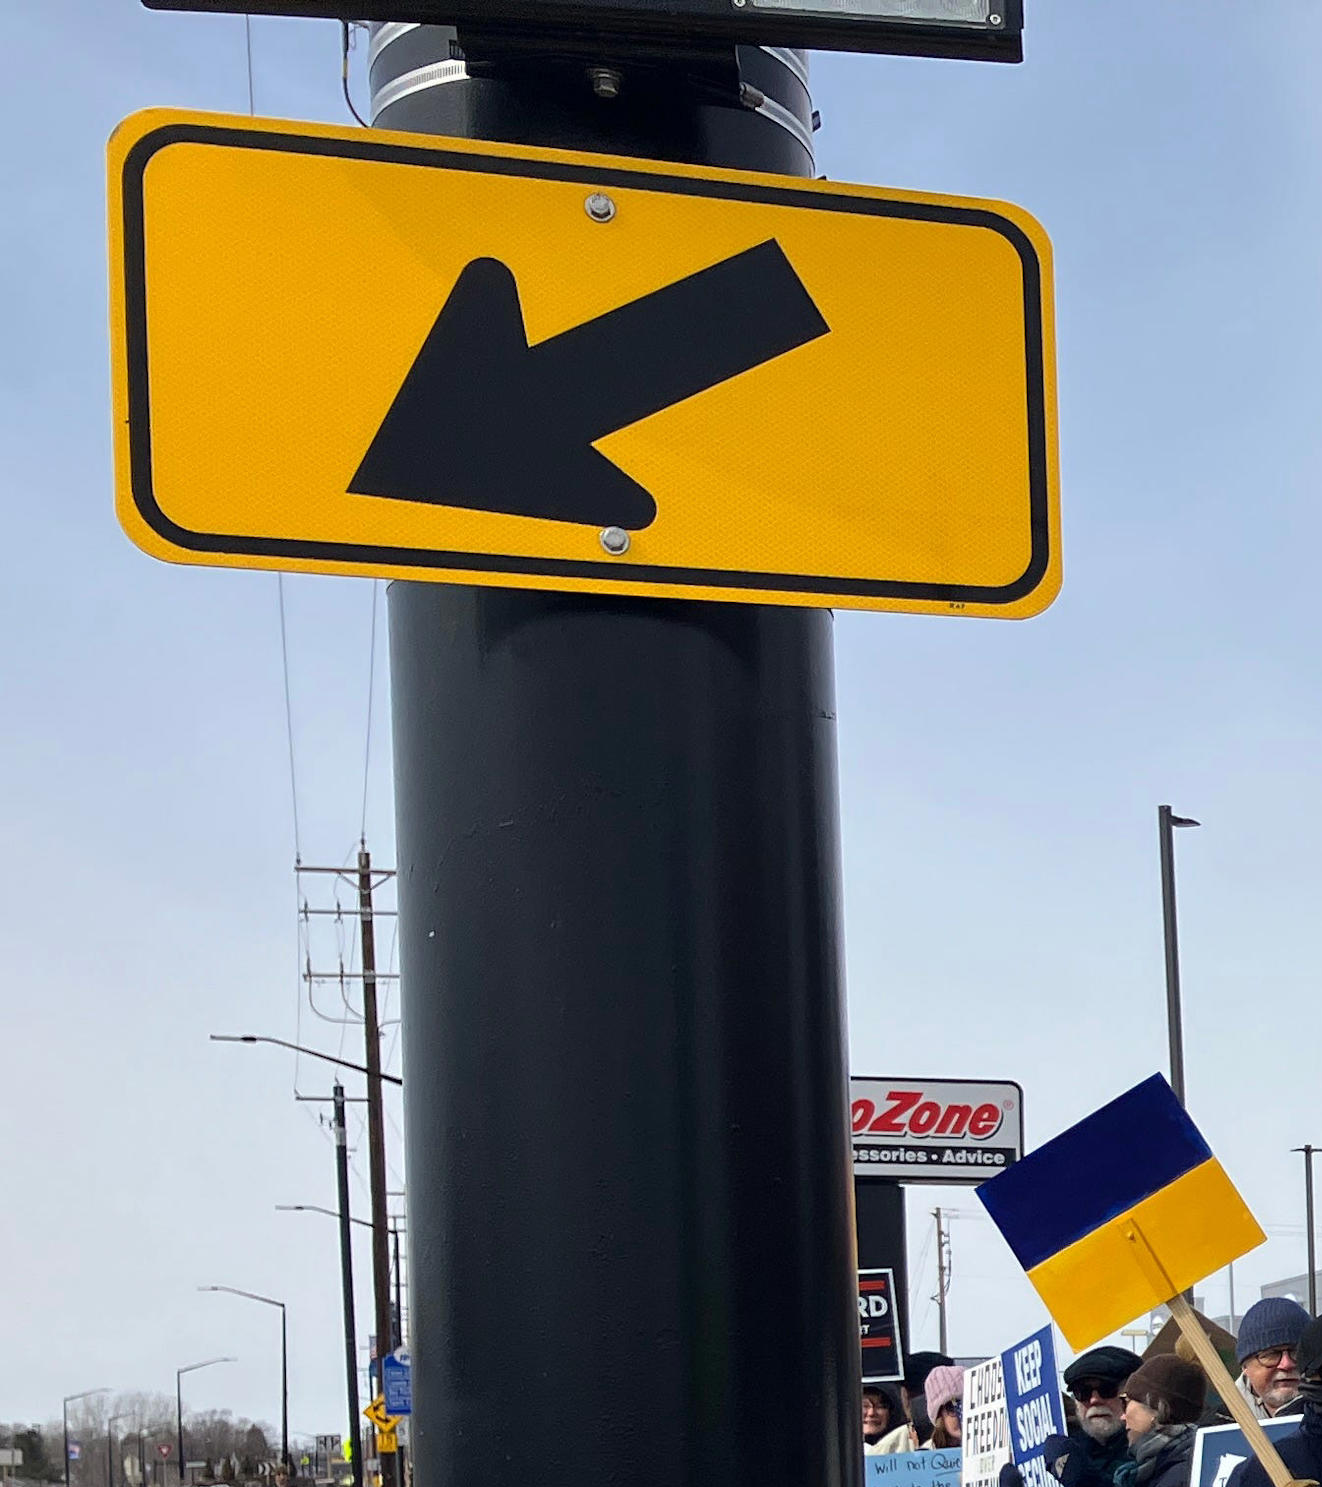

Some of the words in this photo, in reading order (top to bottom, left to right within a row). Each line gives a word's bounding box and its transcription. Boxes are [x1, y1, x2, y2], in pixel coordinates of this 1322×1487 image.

[942, 1150, 1006, 1165] Advice
[970, 1361, 1004, 1410] CHOOS
[1014, 1339, 1043, 1396] KEEP
[1016, 1393, 1058, 1452] SOCIAL
